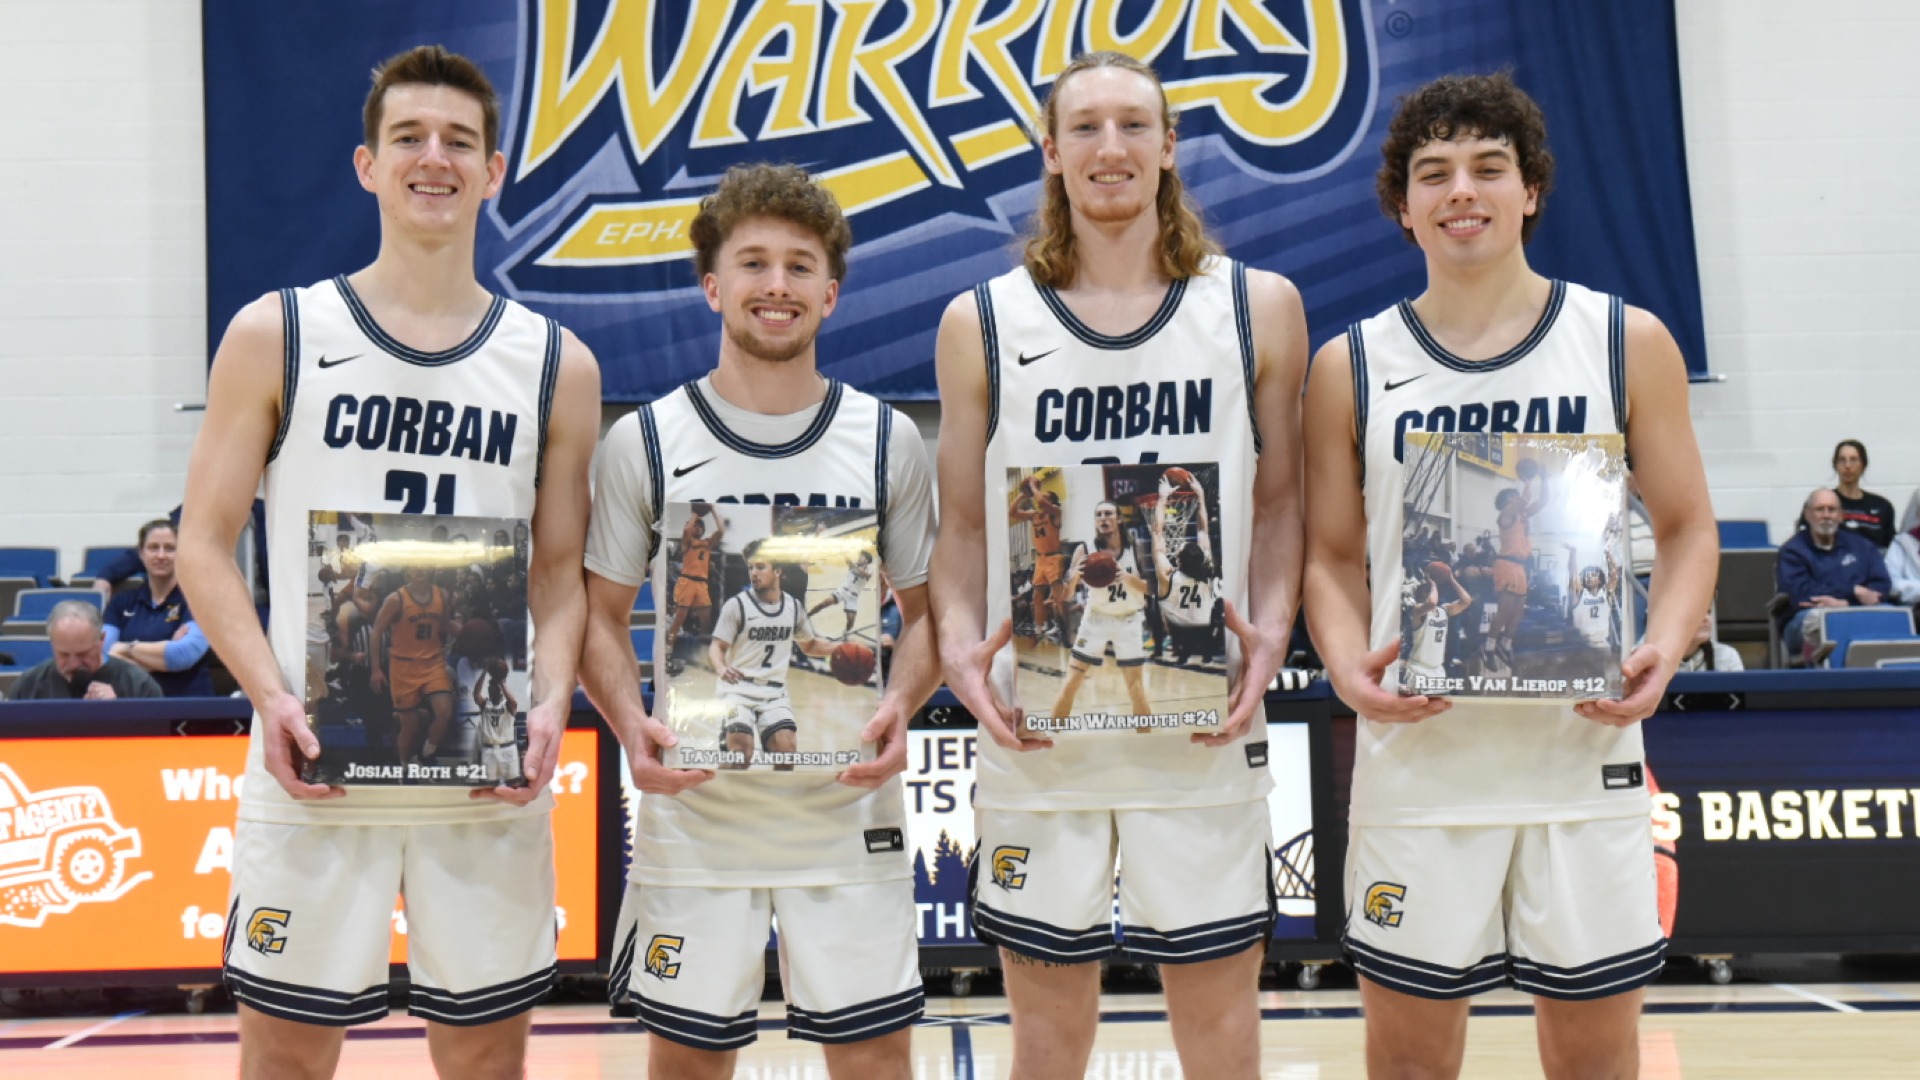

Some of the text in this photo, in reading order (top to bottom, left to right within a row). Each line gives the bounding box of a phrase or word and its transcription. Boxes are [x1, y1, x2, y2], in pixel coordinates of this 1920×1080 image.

[596, 220, 687, 245] EPH.
[1034, 378, 1212, 443] CORBAN
[323, 393, 517, 467] CORBAN
[1393, 396, 1588, 464] CORBAN
[1108, 583, 1127, 602] 24
[1179, 584, 1202, 609] 24
[749, 626, 792, 640] CORBAN
[761, 645, 776, 668] 2
[1415, 675, 1605, 692] REECE VAN LIEROP #12
[1026, 709, 1218, 731] COLLIN WARMOUTH #24
[680, 747, 860, 765] TAYLOR ANDERSON #2
[344, 762, 487, 779] JOSIAH ROTH #21
[15, 795, 97, 838] AGENT?
[915, 902, 976, 938] TH
